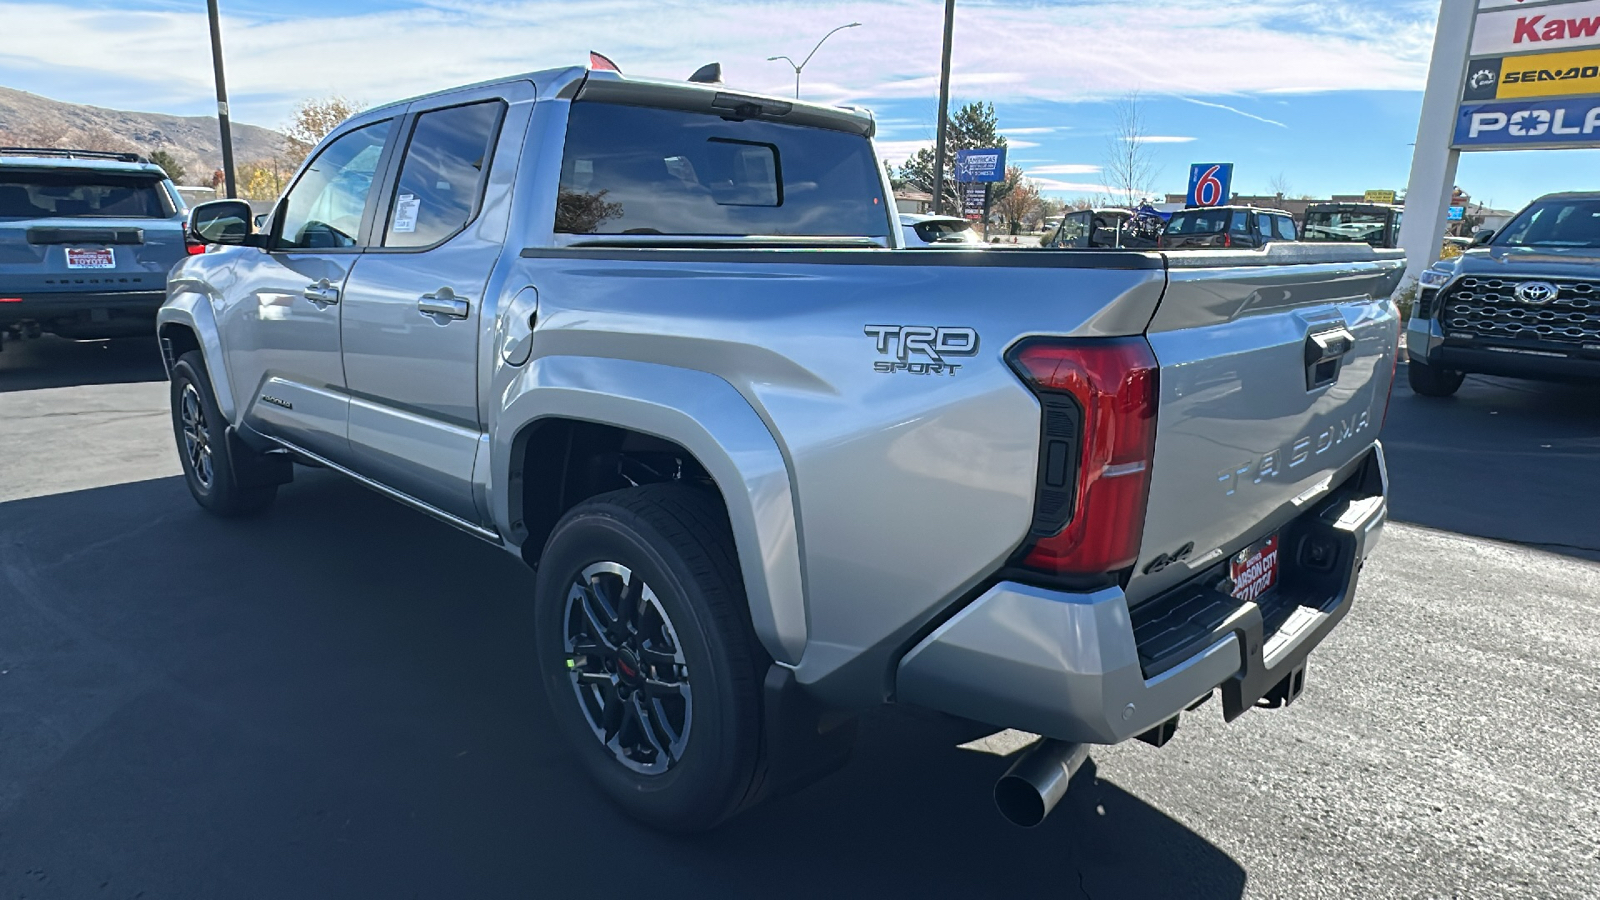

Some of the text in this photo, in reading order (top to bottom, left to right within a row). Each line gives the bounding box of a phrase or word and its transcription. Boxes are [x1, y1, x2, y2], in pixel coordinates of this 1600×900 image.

[1513, 15, 1600, 43] Kaw
[1195, 164, 1222, 205] 6
[864, 324, 980, 362] TRD
[873, 361, 963, 376] SPORT
[1218, 407, 1372, 496] TACOMA
[1262, 549, 1278, 572] CITY
